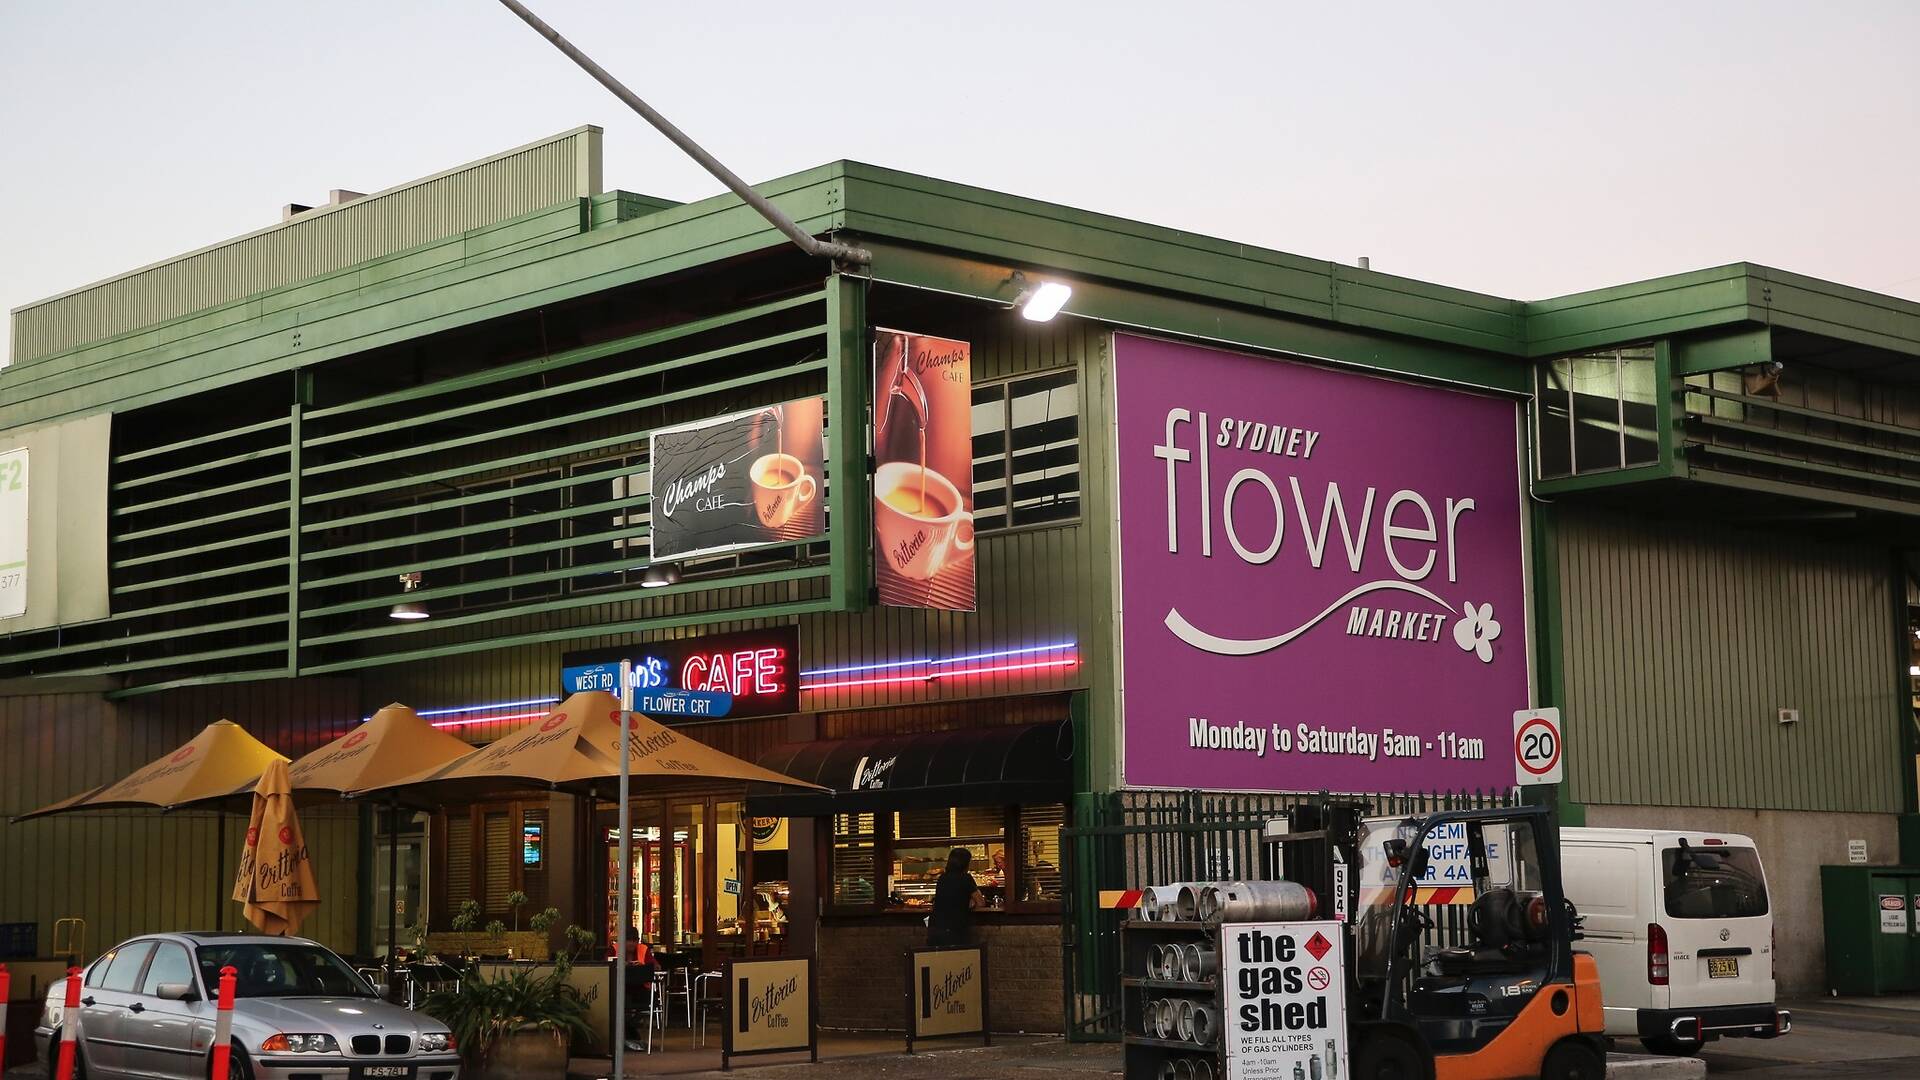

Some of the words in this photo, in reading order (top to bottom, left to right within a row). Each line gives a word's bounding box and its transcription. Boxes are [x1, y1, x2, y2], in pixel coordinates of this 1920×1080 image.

[917, 349, 964, 375] Champs
[1215, 417, 1319, 458] SYDNEY
[663, 462, 726, 517] Champs
[696, 494, 724, 512] CAFE
[1153, 408, 1475, 583] flower
[1346, 606, 1446, 642] MARKET
[575, 674, 598, 690] WEST
[601, 673, 613, 688] RD
[682, 648, 778, 696] CAFE
[643, 696, 686, 713] FLOWER
[690, 699, 711, 714] CRT
[1189, 717, 1267, 757] Monday
[1272, 723, 1292, 752] to
[1297, 723, 1378, 761] Saturday
[1383, 728, 1421, 757] 5am
[1437, 731, 1484, 759] 11am
[1523, 732, 1554, 760] 20
[1427, 823, 1464, 840] SEMI
[725, 881, 738, 892] OPEN
[1444, 865, 1473, 881] 4A
[1237, 930, 1296, 963] the
[931, 965, 972, 1010] Vittoria
[1238, 966, 1303, 1000] gas
[752, 976, 798, 1023] Vittoria
[946, 1000, 966, 1014] Coffee
[767, 1013, 789, 1028] Coffee
[1240, 996, 1327, 1032] shed
[1241, 1036, 1253, 1045] WE
[1254, 1036, 1271, 1044] FILL
[1272, 1035, 1287, 1043] ALL
[1288, 1034, 1312, 1042] TYPES
[1241, 1046, 1253, 1054] OF
[1254, 1045, 1270, 1053] GAS
[1271, 1043, 1314, 1052] CYLINDERS
[1242, 1067, 1264, 1075] Unless
[1264, 1066, 1280, 1074] Prior
